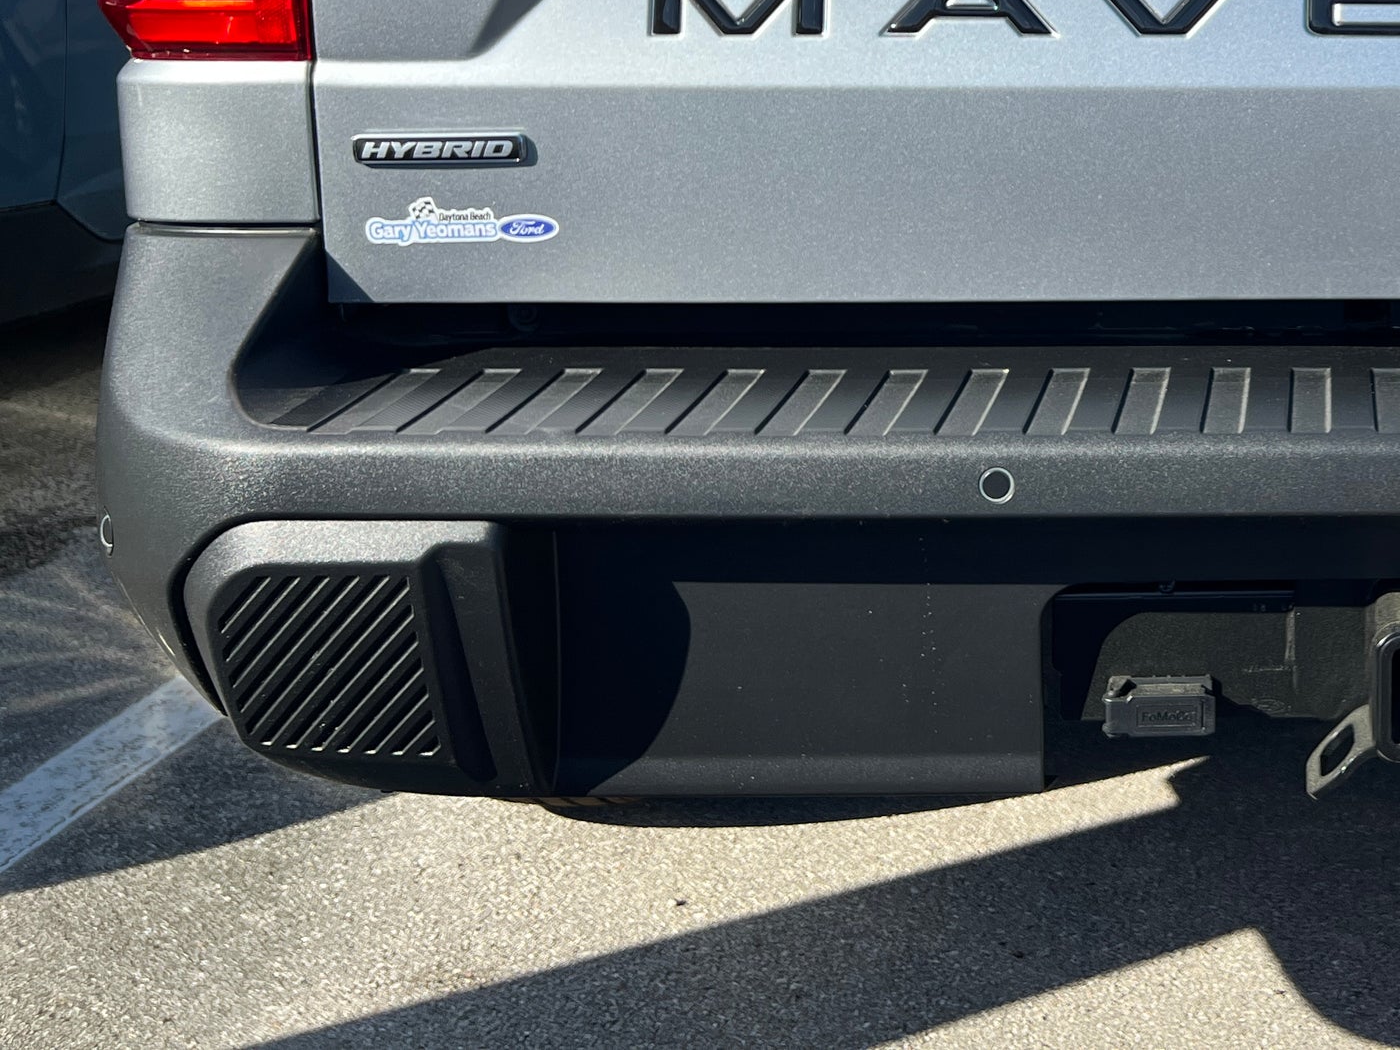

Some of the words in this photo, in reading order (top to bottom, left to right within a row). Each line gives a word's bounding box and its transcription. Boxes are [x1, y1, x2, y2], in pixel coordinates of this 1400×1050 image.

[361, 140, 513, 159] HYBRID
[439, 212, 469, 222] Daytona
[470, 212, 492, 221] Beach
[509, 220, 545, 236] Ford
